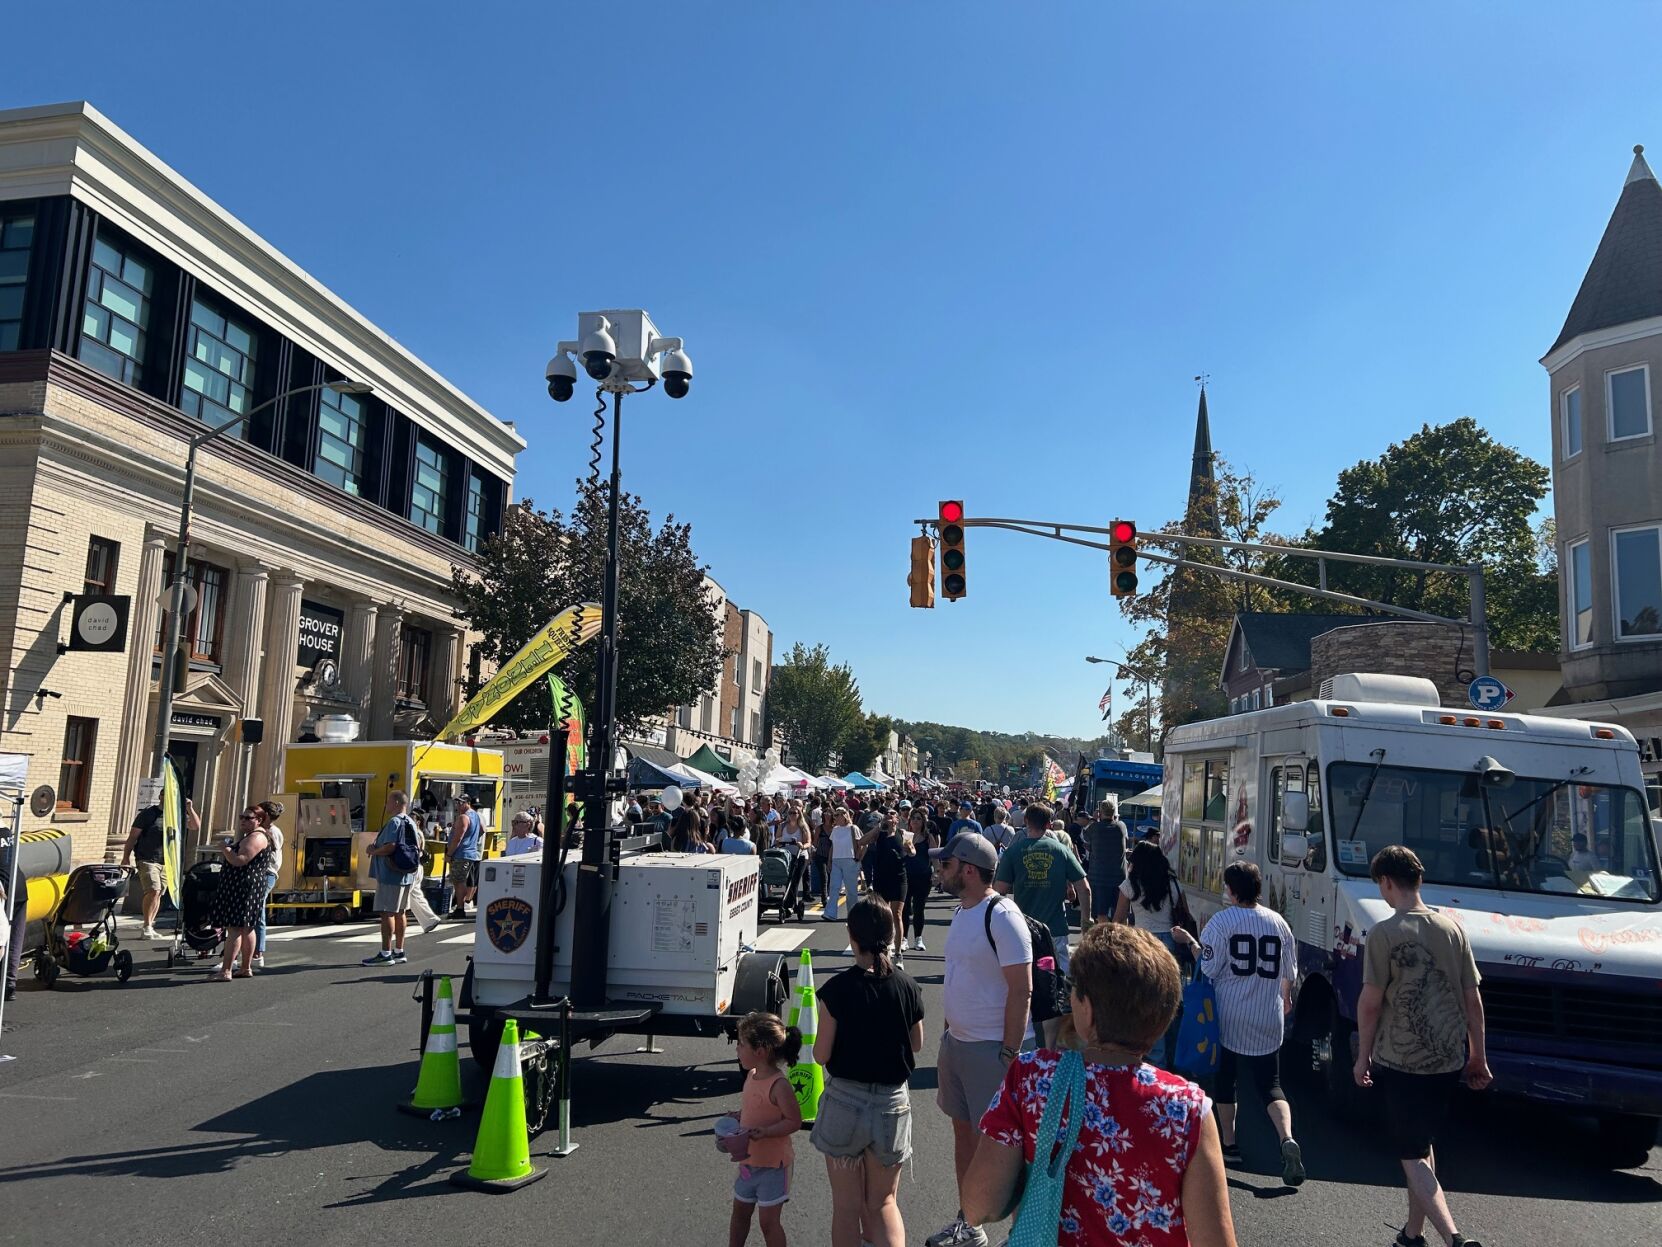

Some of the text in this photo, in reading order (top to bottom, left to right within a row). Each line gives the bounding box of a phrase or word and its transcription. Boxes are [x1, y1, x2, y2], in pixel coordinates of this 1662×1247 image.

[299, 615, 339, 637] GROVER
[299, 632, 334, 653] HOUSE
[1477, 685, 1500, 704] P
[172, 715, 213, 725] david chad
[503, 764, 524, 773] OW!
[727, 872, 758, 905] SHERIFF
[488, 900, 531, 916] SHERIFF
[740, 898, 753, 913] COUNTY
[1230, 934, 1281, 979] 99
[626, 992, 705, 1002] PACKETALK
